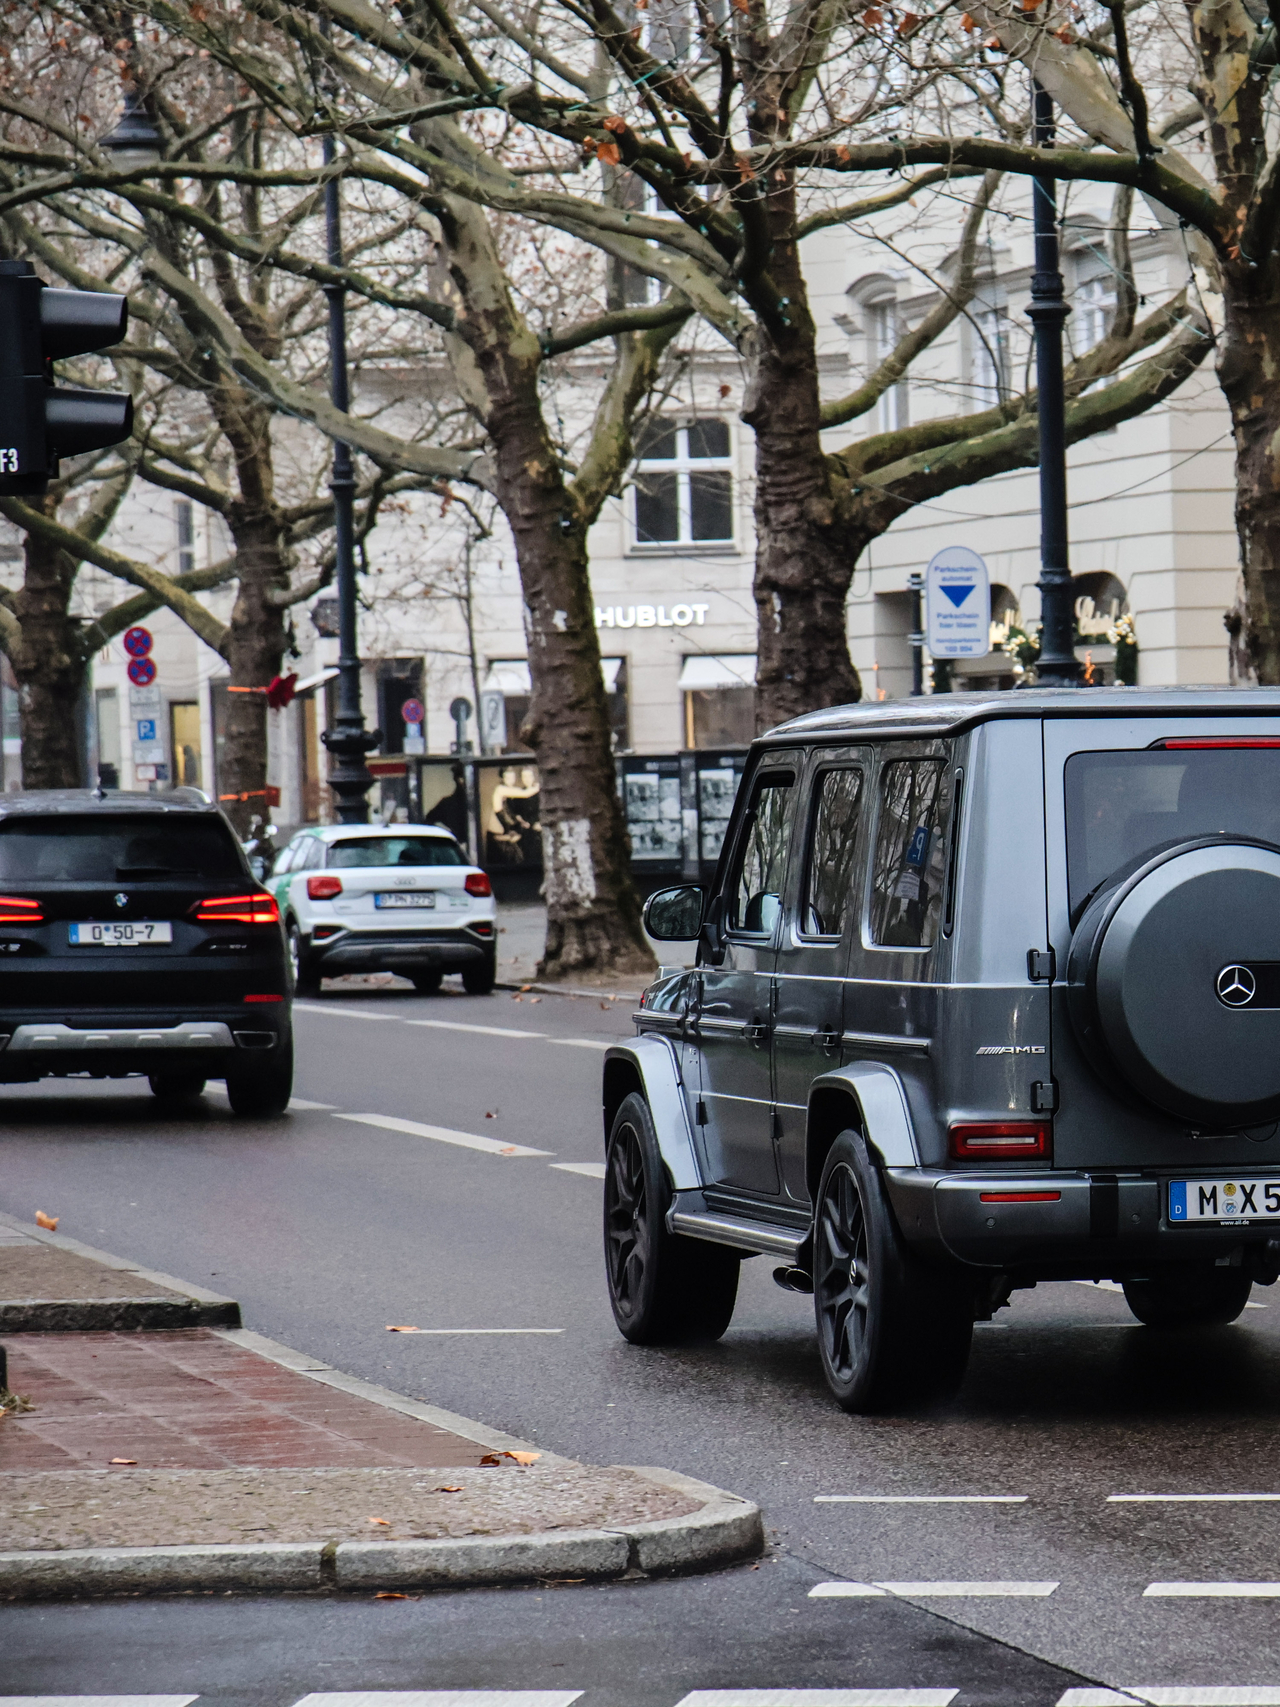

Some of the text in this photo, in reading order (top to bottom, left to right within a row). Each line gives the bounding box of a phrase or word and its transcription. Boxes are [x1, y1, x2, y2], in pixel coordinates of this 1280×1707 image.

[594, 604, 709, 628] HUBLOT
[999, 1046, 1046, 1054] AMG
[1199, 1185, 1218, 1215] M
[1175, 1205, 1182, 1214] D
